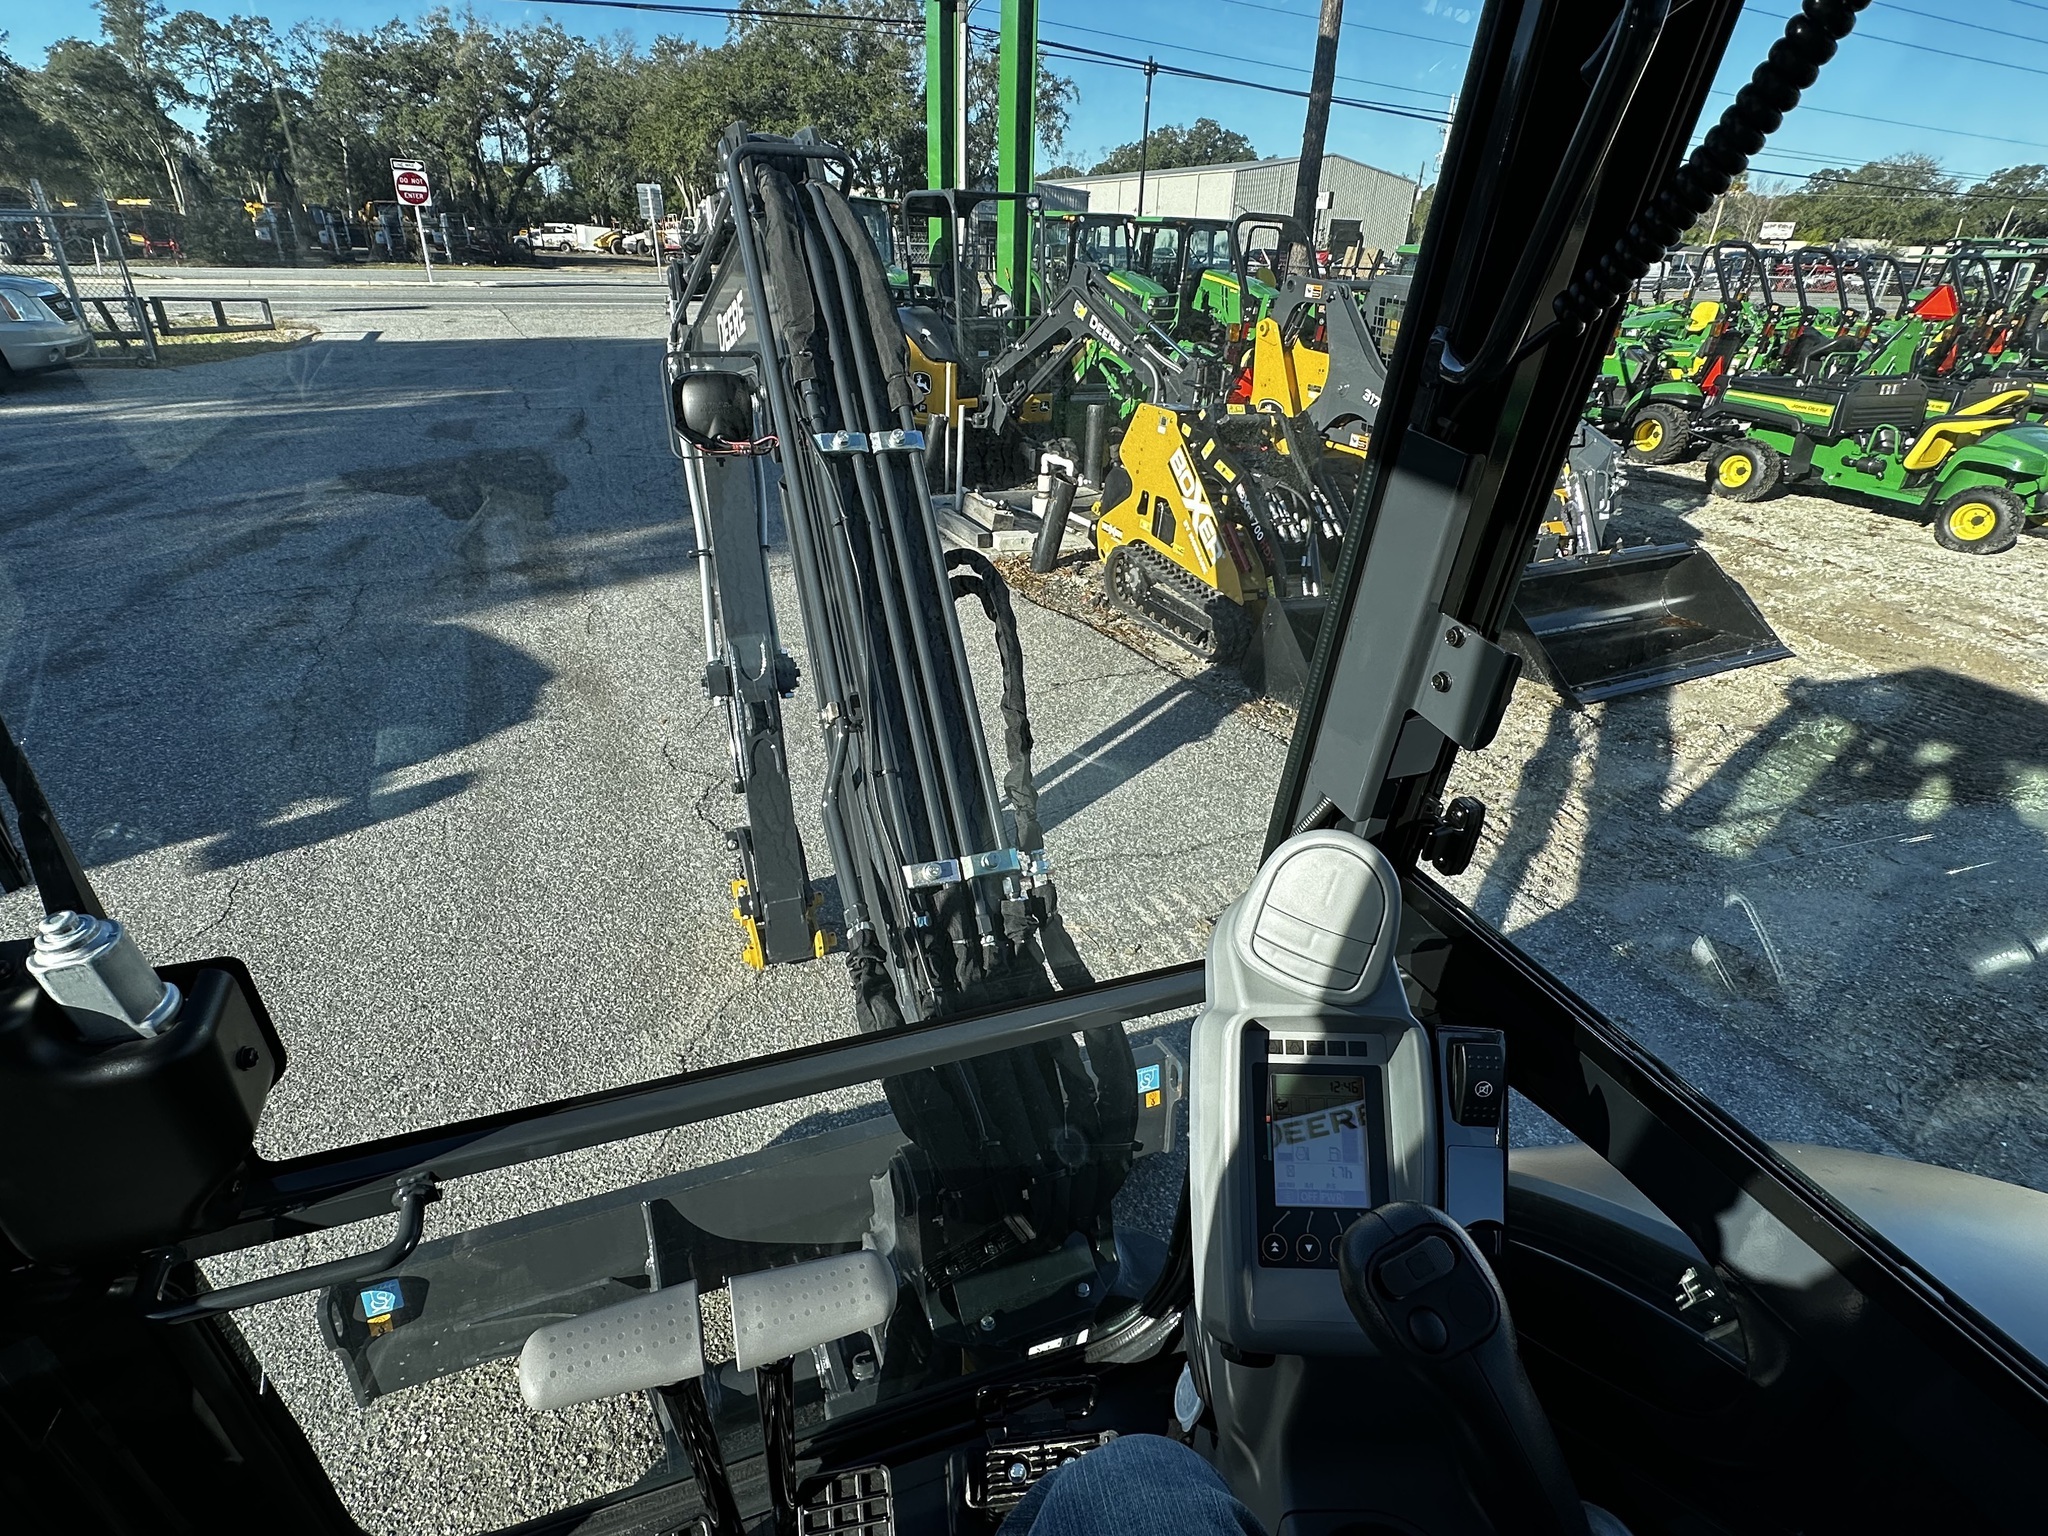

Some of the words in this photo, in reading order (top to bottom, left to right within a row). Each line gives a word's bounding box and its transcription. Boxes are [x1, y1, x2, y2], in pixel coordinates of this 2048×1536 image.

[404, 192, 424, 200] ENTER
[717, 289, 747, 352] DEERE
[1089, 314, 1122, 352] DEERE
[1169, 445, 1223, 567] BOXER
[1251, 518, 1264, 540] 700
[1329, 1081, 1359, 1093] 12:46
[1300, 1191, 1318, 1201] OFF
